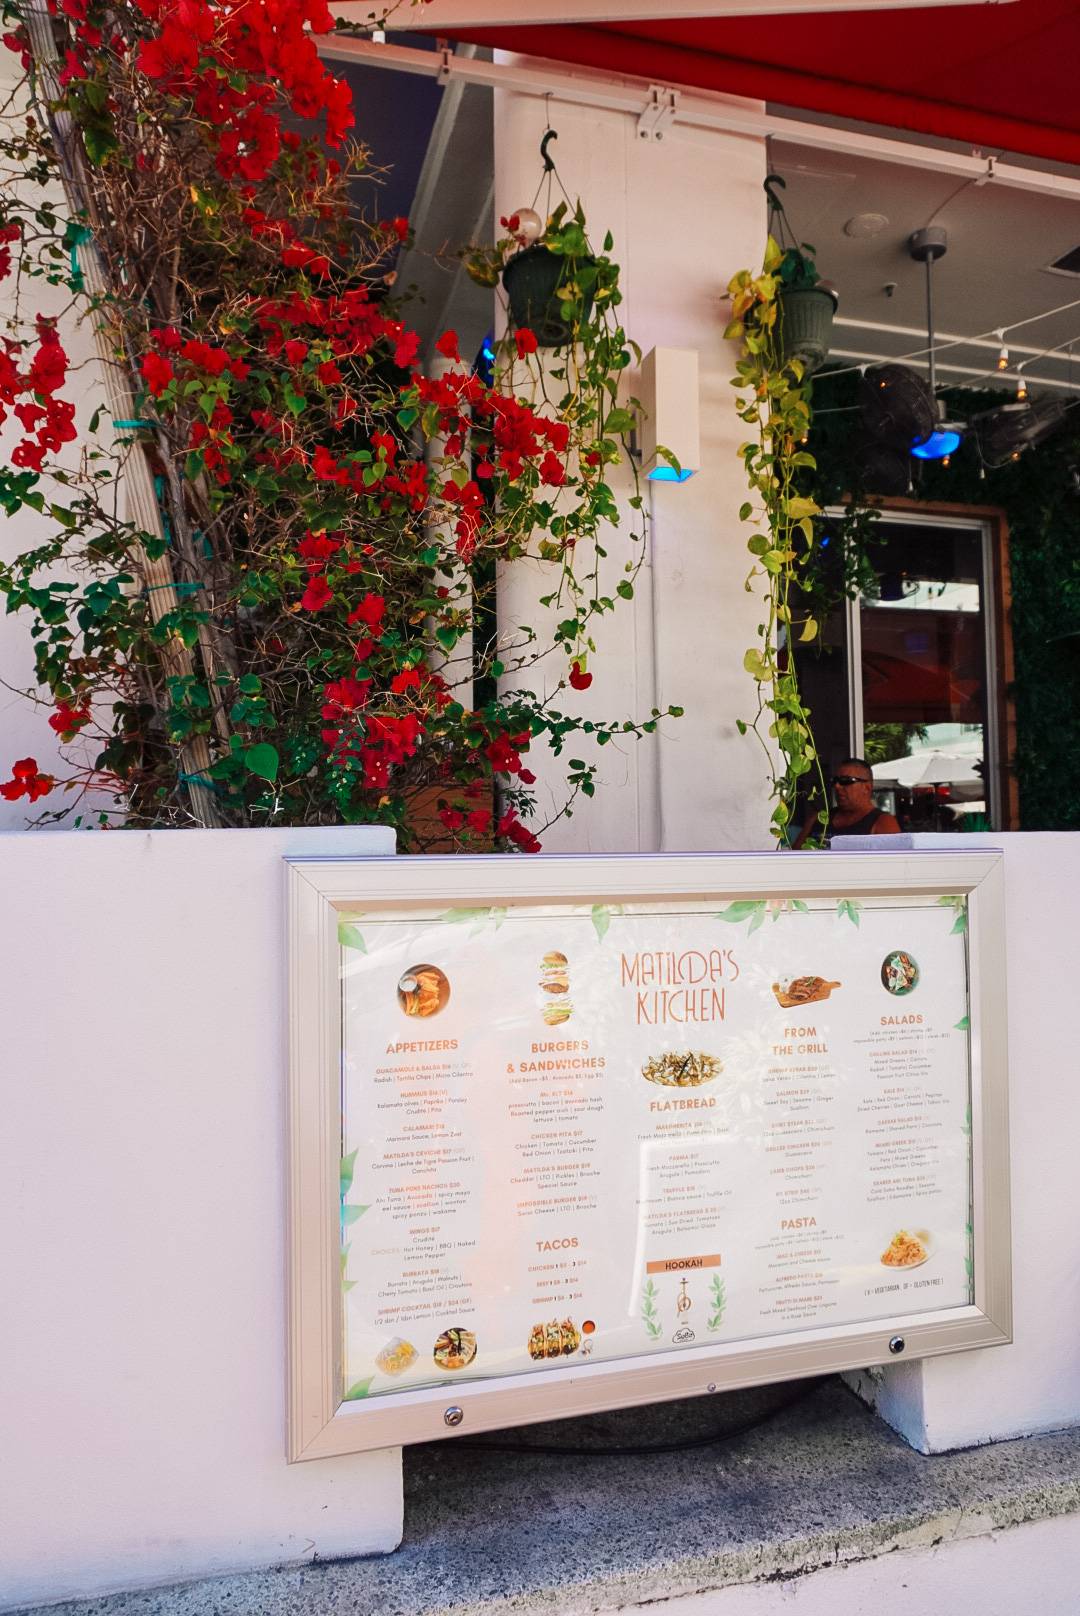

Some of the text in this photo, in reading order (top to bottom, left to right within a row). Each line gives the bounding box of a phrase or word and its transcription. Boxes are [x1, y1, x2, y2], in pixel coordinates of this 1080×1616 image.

[621, 949, 740, 987] MATILDA'S
[637, 987, 725, 1024] KITCHEN
[880, 1014, 924, 1026] SALADS
[784, 1026, 816, 1038] FROM
[386, 1039, 458, 1054] APPETIZERS
[531, 1040, 589, 1053] BURGERS
[772, 1043, 828, 1055] THE GRILL
[507, 1057, 606, 1073] & SANDWICHES
[650, 1098, 716, 1112] FLATBREAD
[781, 1216, 817, 1230] PASTA
[536, 1237, 578, 1252] TACOS
[665, 1259, 703, 1270] HOOKAH
